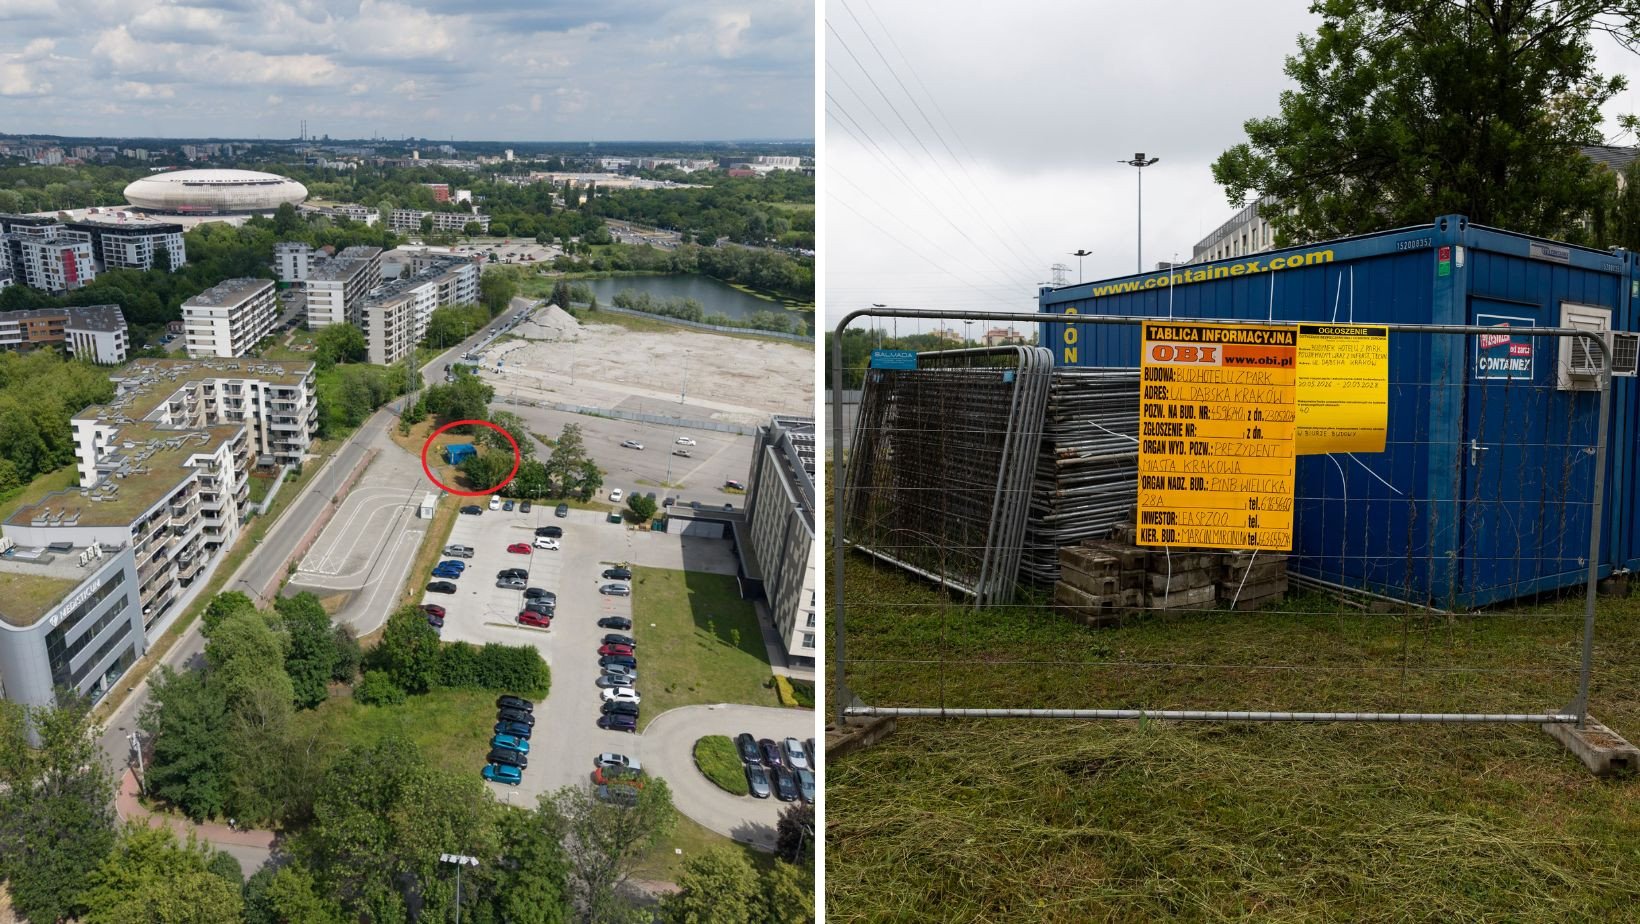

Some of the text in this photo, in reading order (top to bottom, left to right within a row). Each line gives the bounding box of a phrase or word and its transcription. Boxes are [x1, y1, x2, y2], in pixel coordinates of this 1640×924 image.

[1092, 249, 1335, 298] www.containex.com
[1150, 327, 1293, 345] TABLICA INFORMACYJNA
[1318, 327, 1368, 335] OGŁOSZENIE
[1152, 345, 1217, 363] OBI
[1224, 356, 1293, 367] www.obi.pl
[1480, 357, 1531, 371] CONTAINEX
[1144, 367, 1176, 382] BUDOWA:
[1144, 385, 1169, 400] ADRES:
[1190, 387, 1231, 403] DĄBSKA
[1234, 387, 1282, 404] KRAKÓW
[1143, 404, 1166, 419] POZW.
[1168, 404, 1178, 419] NA
[1180, 405, 1196, 420] BUD.
[1199, 405, 1211, 420] NR:
[1247, 410, 1252, 421] z
[1253, 408, 1265, 421] dn.
[1143, 422, 1264, 439] ZGŁOSZENIE NR: z dn.
[1143, 440, 1281, 457] ORGAN WYD. POZW.: PREZYDENT
[1143, 458, 1242, 474] MIASTA KRAKOWA
[1142, 475, 1287, 494] ORGAN NADZ. BUD.: PINB WIELICKA
[1142, 493, 1164, 507] 28A
[1248, 496, 1261, 511] tel.
[1141, 510, 1178, 526] INWESTOR:
[1248, 514, 1260, 528] tel.
[1140, 528, 1159, 543] KIER.
[1161, 529, 1180, 543] BUD.:
[1247, 532, 1259, 546] tel.
